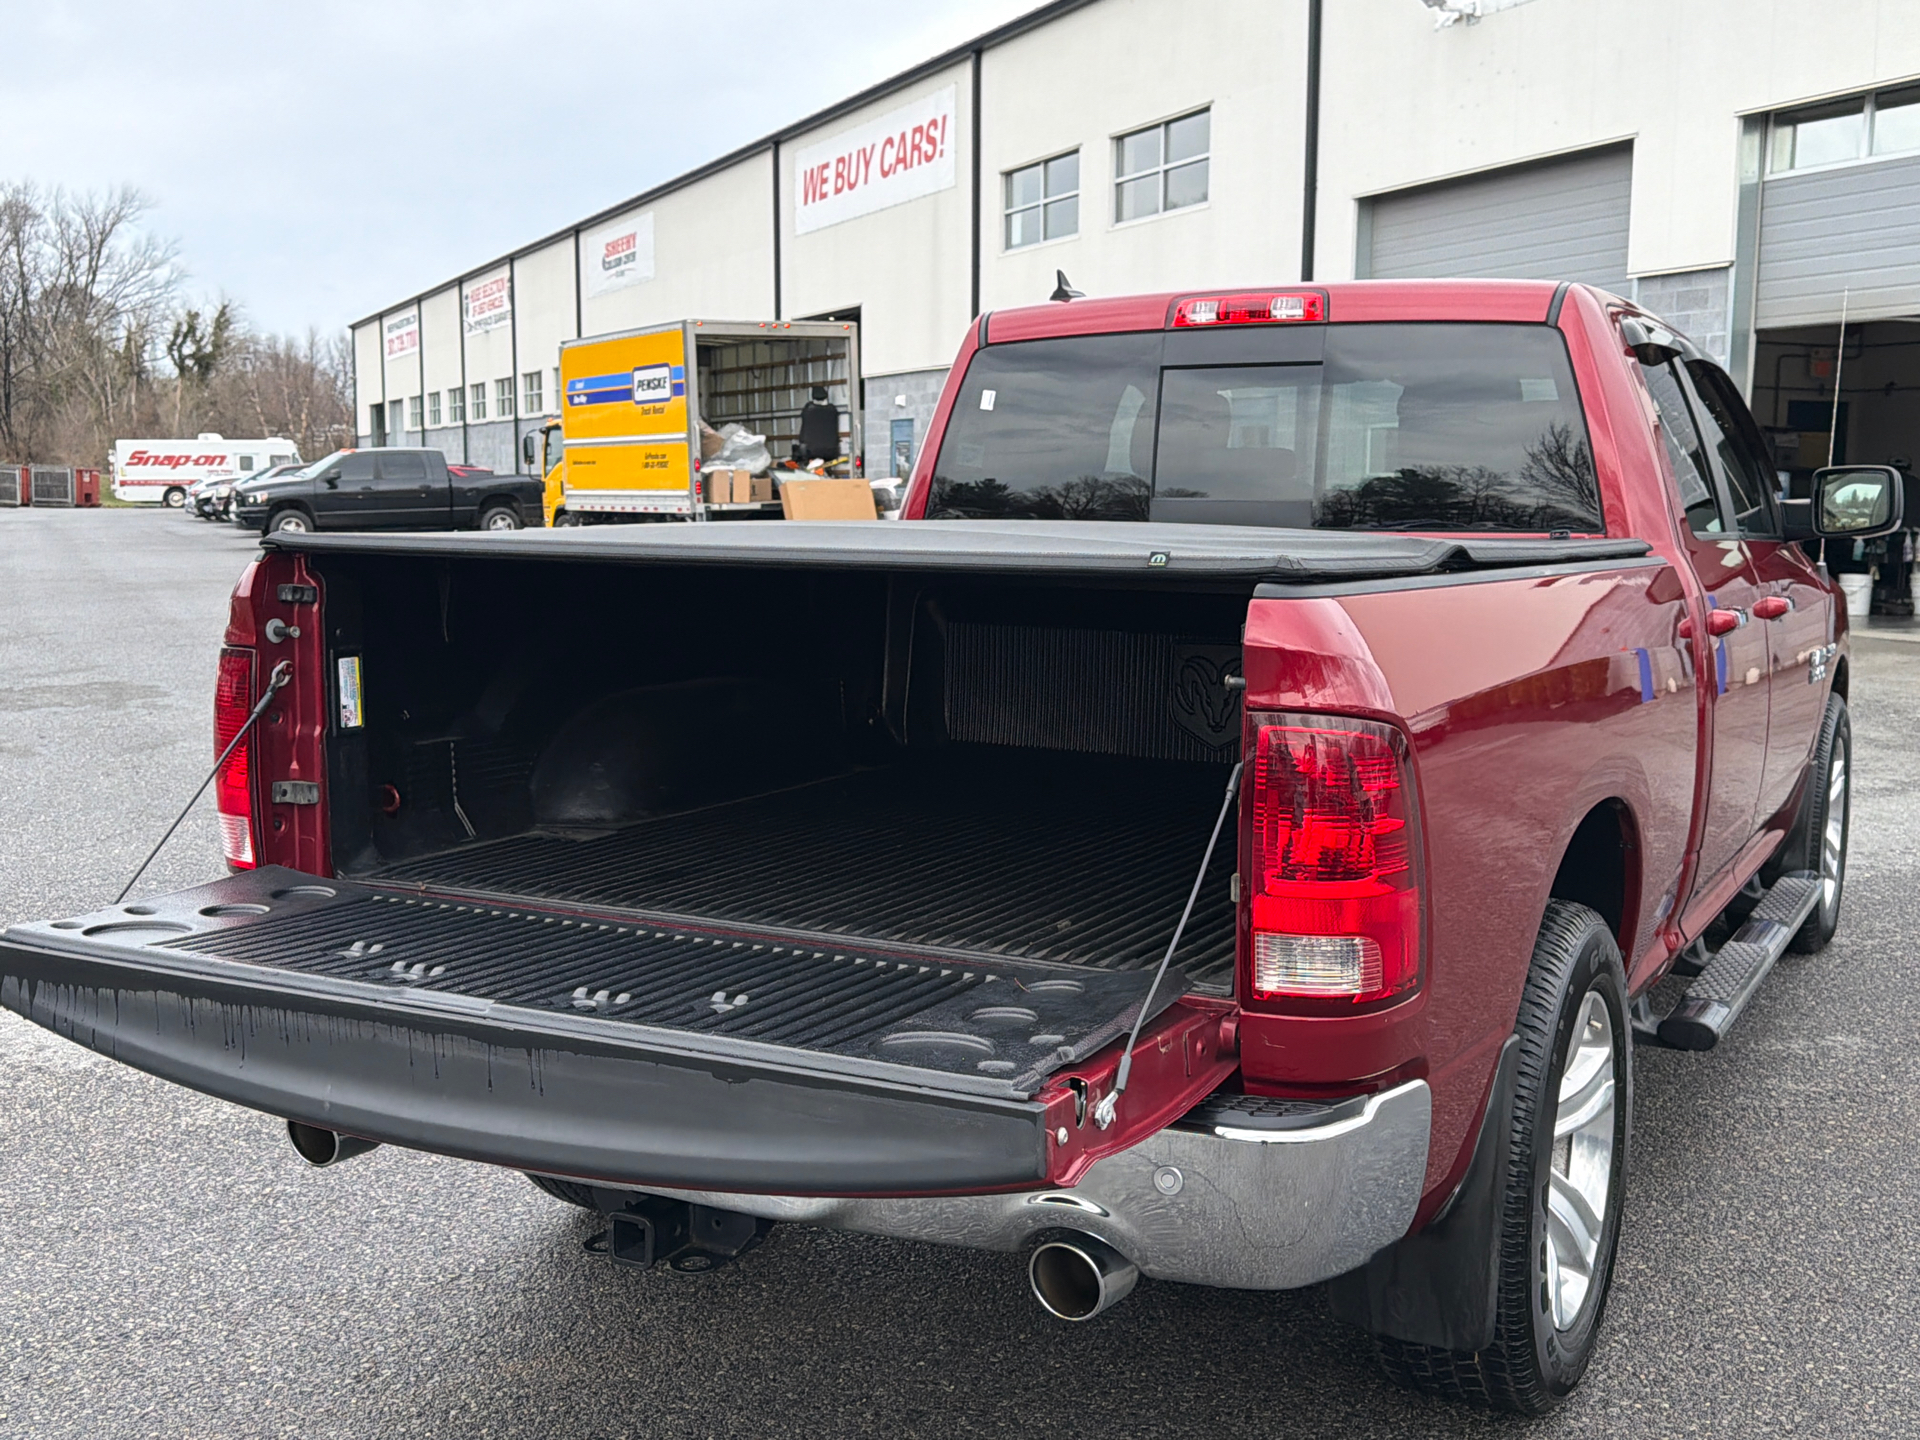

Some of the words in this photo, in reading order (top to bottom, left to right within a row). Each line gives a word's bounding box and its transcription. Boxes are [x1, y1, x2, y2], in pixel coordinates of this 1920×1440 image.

[803, 161, 830, 206] WE
[834, 143, 876, 195] BUY
[880, 114, 948, 179] CARS!
[636, 376, 668, 392] PENSKE
[125, 450, 228, 470] Snap-on
